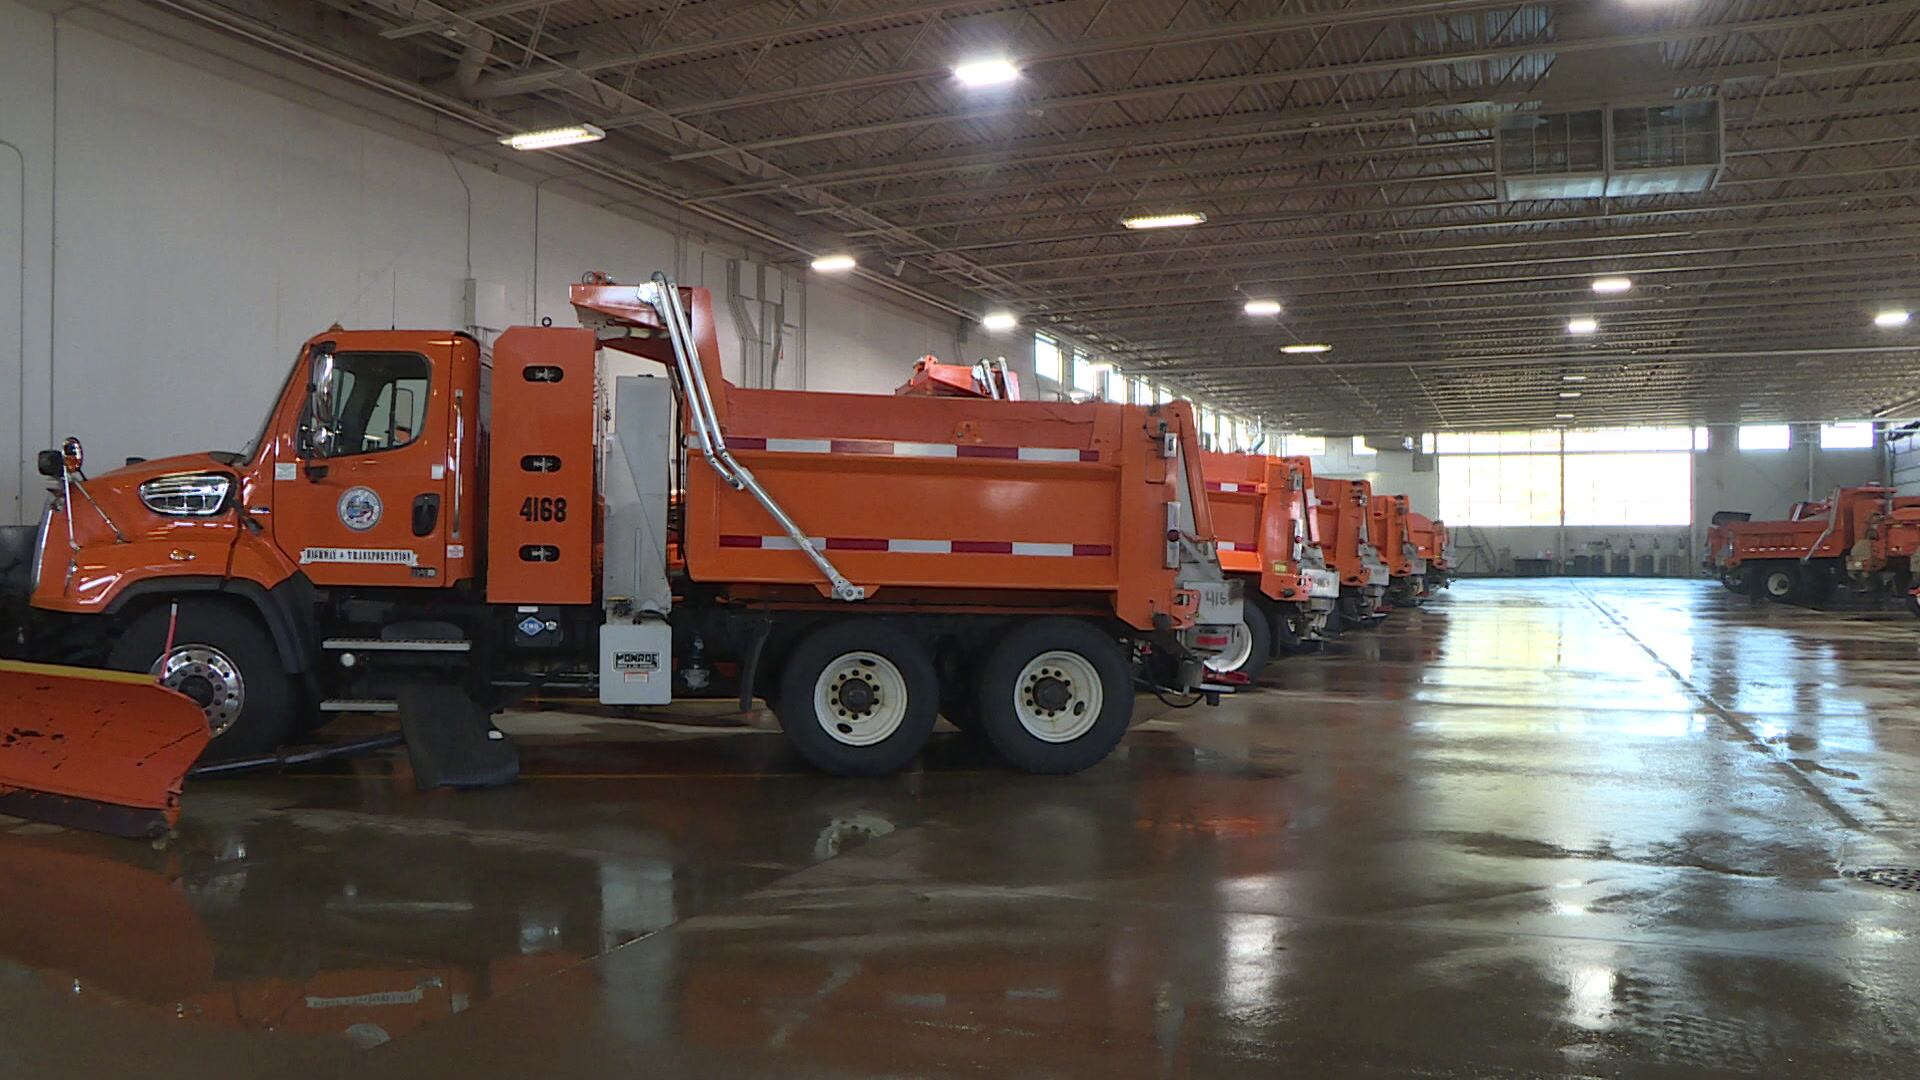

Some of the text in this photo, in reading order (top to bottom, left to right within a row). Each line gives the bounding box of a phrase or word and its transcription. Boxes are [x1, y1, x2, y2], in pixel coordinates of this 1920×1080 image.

[519, 496, 567, 523] 4168
[347, 551, 411, 561] TRANSPORTATION
[615, 653, 658, 668] MONROE
